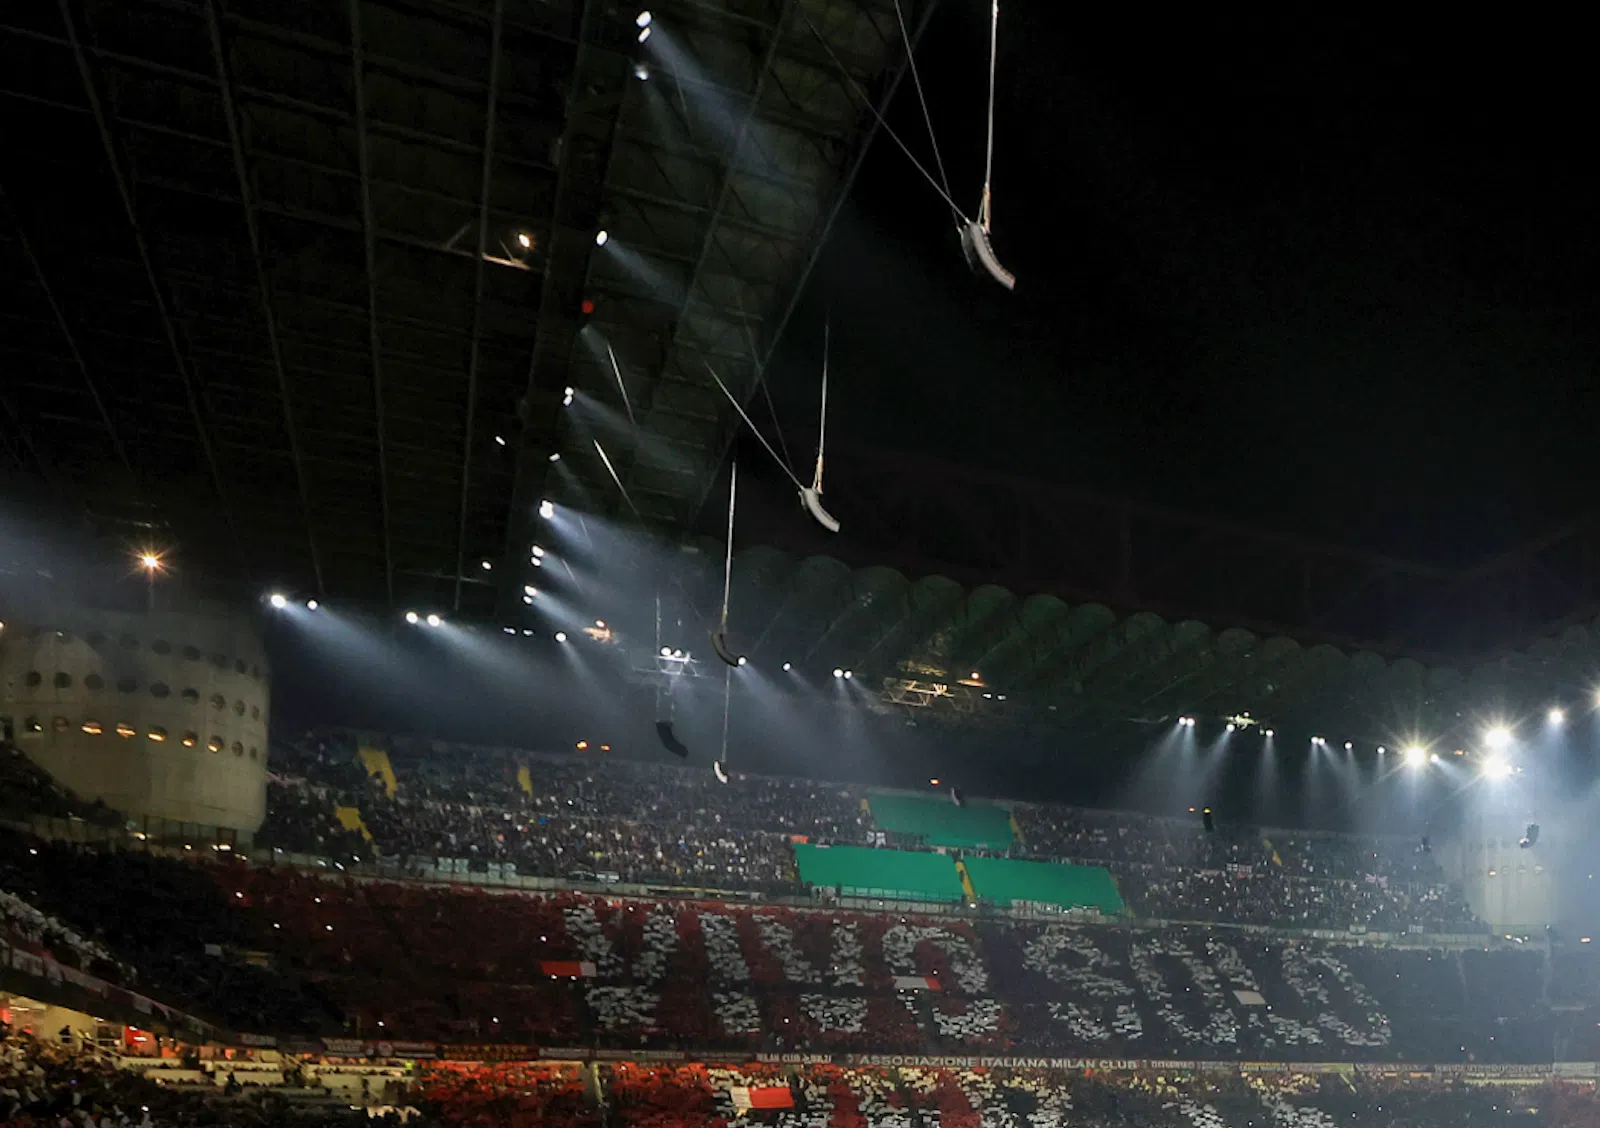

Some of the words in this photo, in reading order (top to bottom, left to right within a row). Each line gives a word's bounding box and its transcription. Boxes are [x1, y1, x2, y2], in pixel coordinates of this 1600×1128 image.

[860, 1055, 977, 1068] ASSOCIAZIONE
[981, 1057, 1048, 1069] ITALIANA
[1051, 1059, 1095, 1069] MILAN
[1099, 1060, 1136, 1070] CLUB
